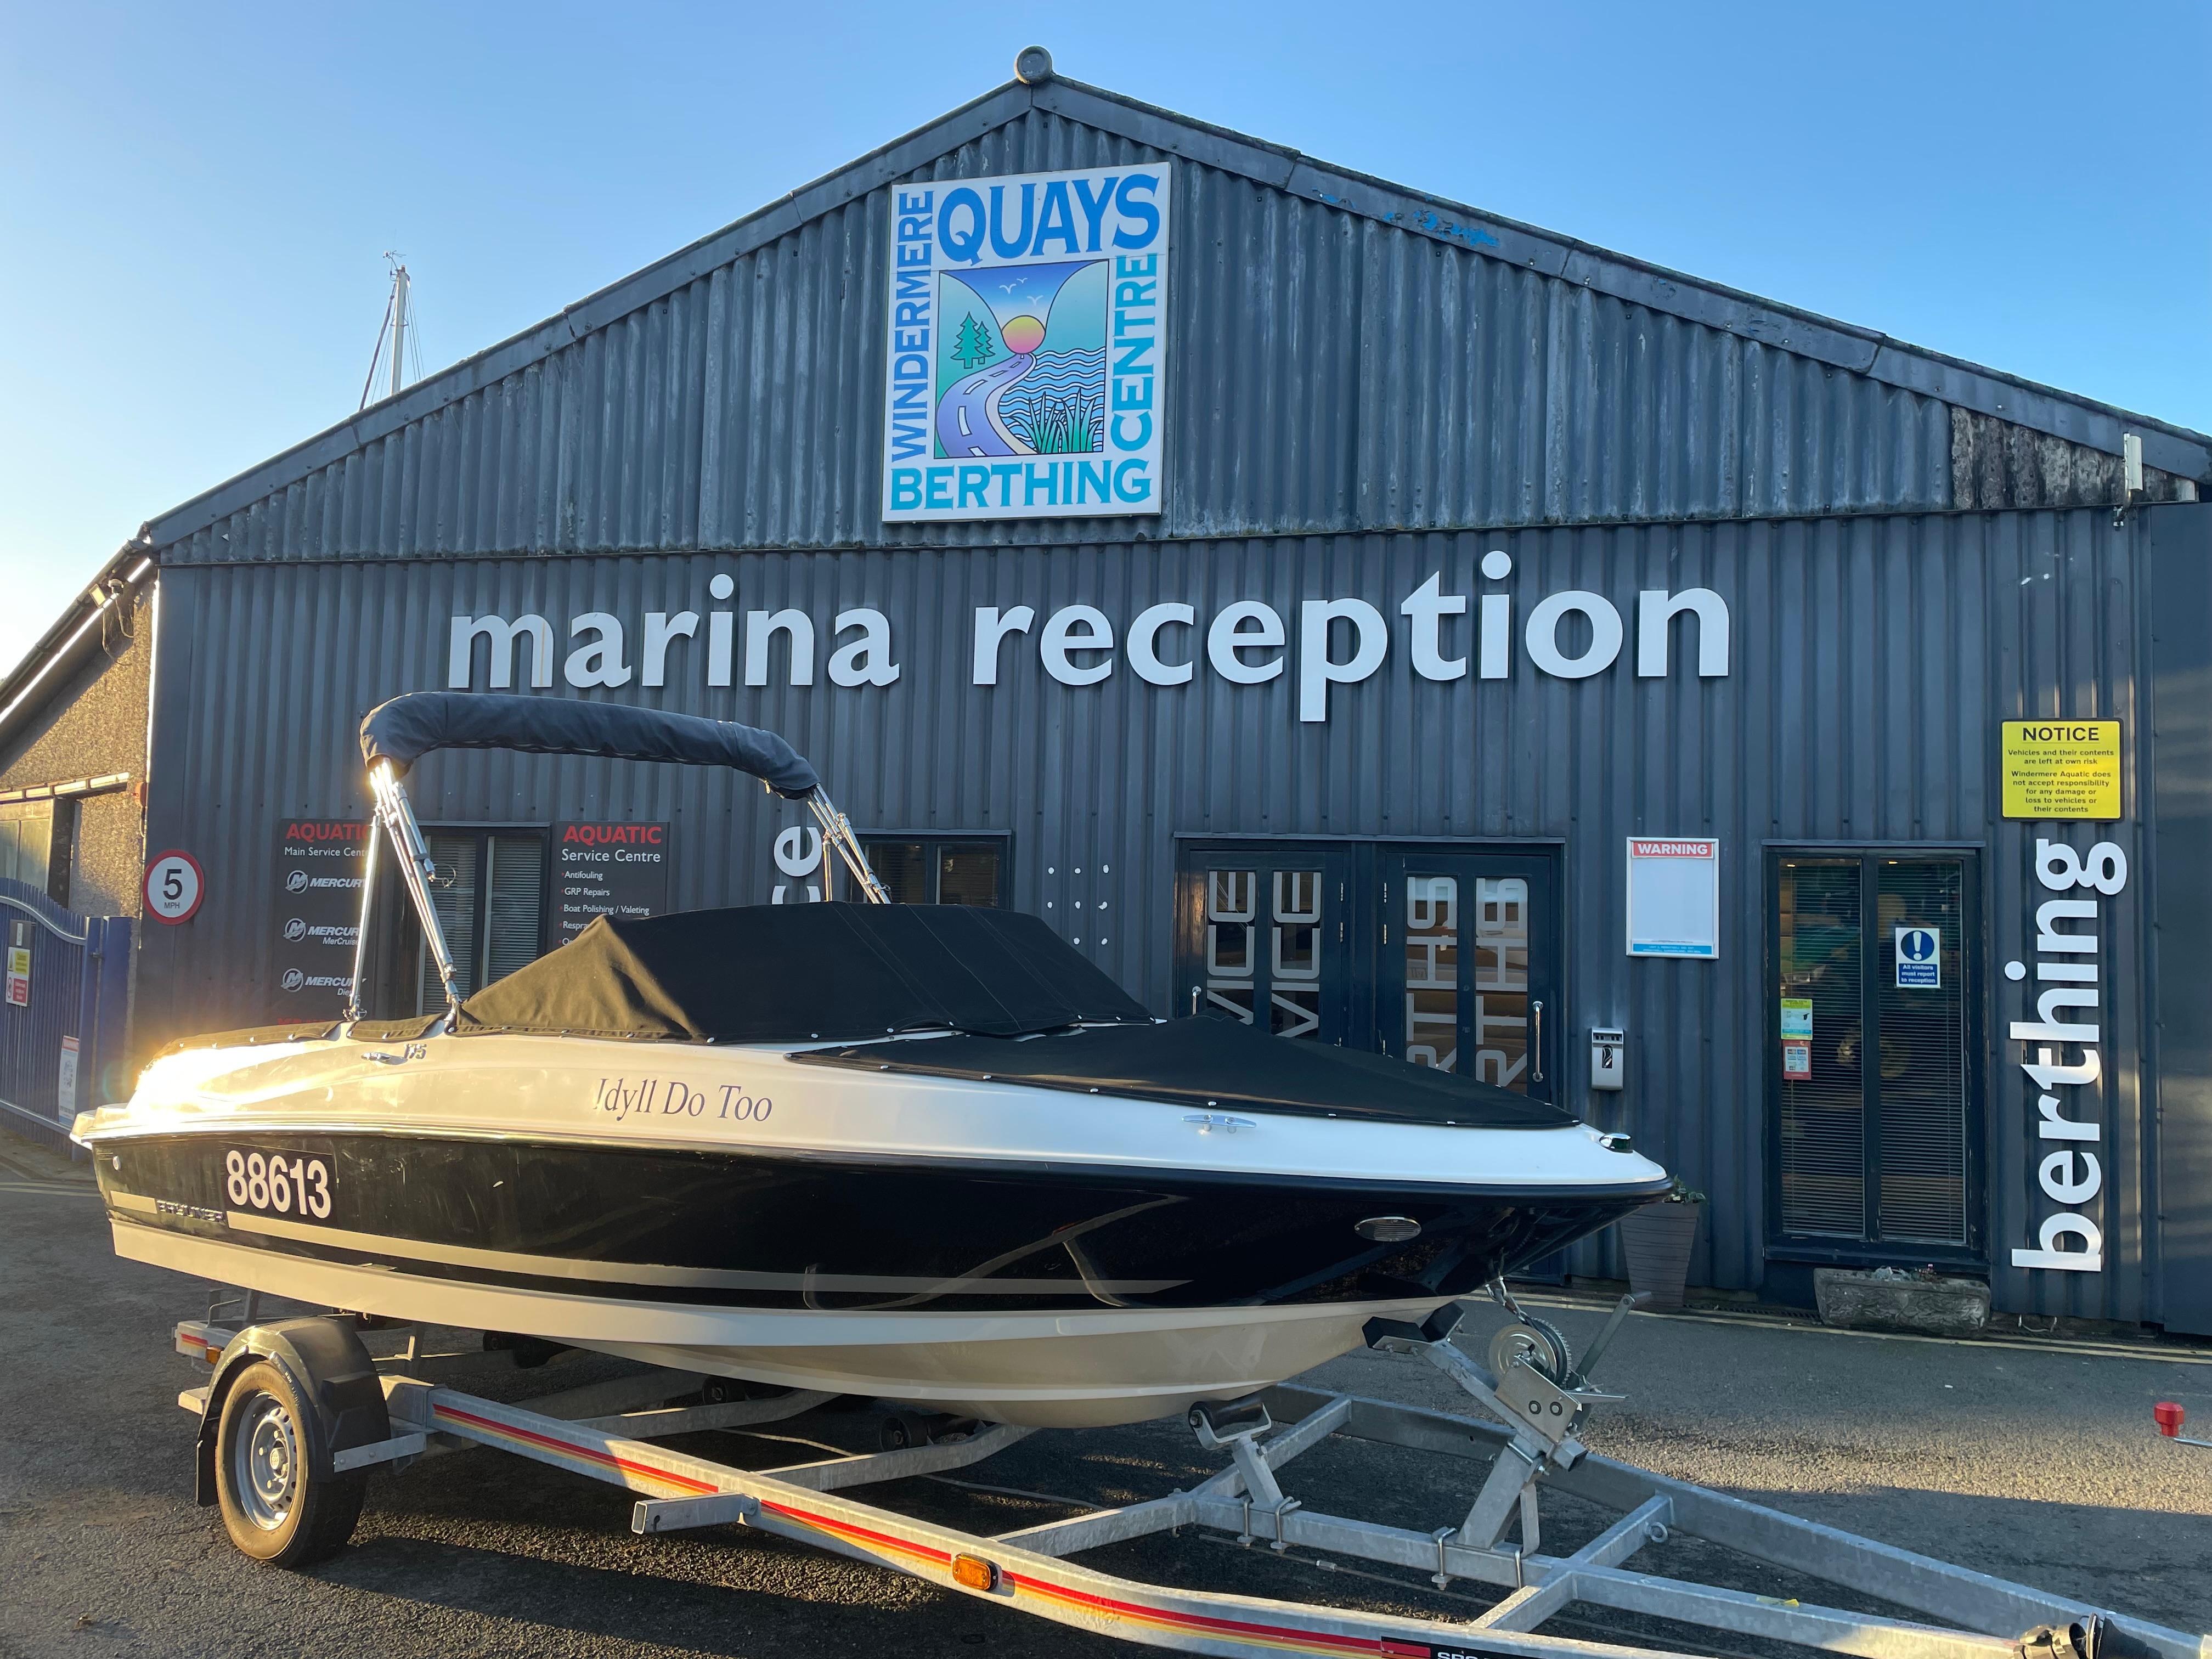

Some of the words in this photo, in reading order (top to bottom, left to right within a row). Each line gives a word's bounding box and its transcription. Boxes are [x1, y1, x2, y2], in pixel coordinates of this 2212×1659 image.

[937, 173, 1160, 266] QUAYS
[892, 190, 933, 462] WINDERMERE
[1111, 253, 1157, 451] CENTRE
[890, 458, 1152, 510] BERTHING
[448, 574, 900, 689] marina
[973, 550, 1729, 722] reception
[2023, 727, 2100, 741] NOTICE
[562, 825, 662, 846] AQUATIC
[285, 847, 305, 856] Main
[308, 847, 340, 856] Service
[562, 848, 610, 862] Service
[614, 849, 661, 862] Centre
[1637, 844, 1708, 855] WARNING
[163, 868, 183, 900] 5
[564, 871, 603, 881] Antifouling
[564, 888, 581, 896] GRP
[583, 888, 610, 898] Repairs
[563, 904, 580, 912] Boat
[583, 905, 614, 915] Polishing
[620, 906, 650, 916] Valeting
[307, 926, 360, 936] MERCUR
[2004, 838, 2128, 1272] berthing
[592, 1077, 657, 1121] Idyll
[661, 1081, 706, 1117] Do
[717, 1085, 772, 1122] Too
[226, 1149, 331, 1219] 88613
